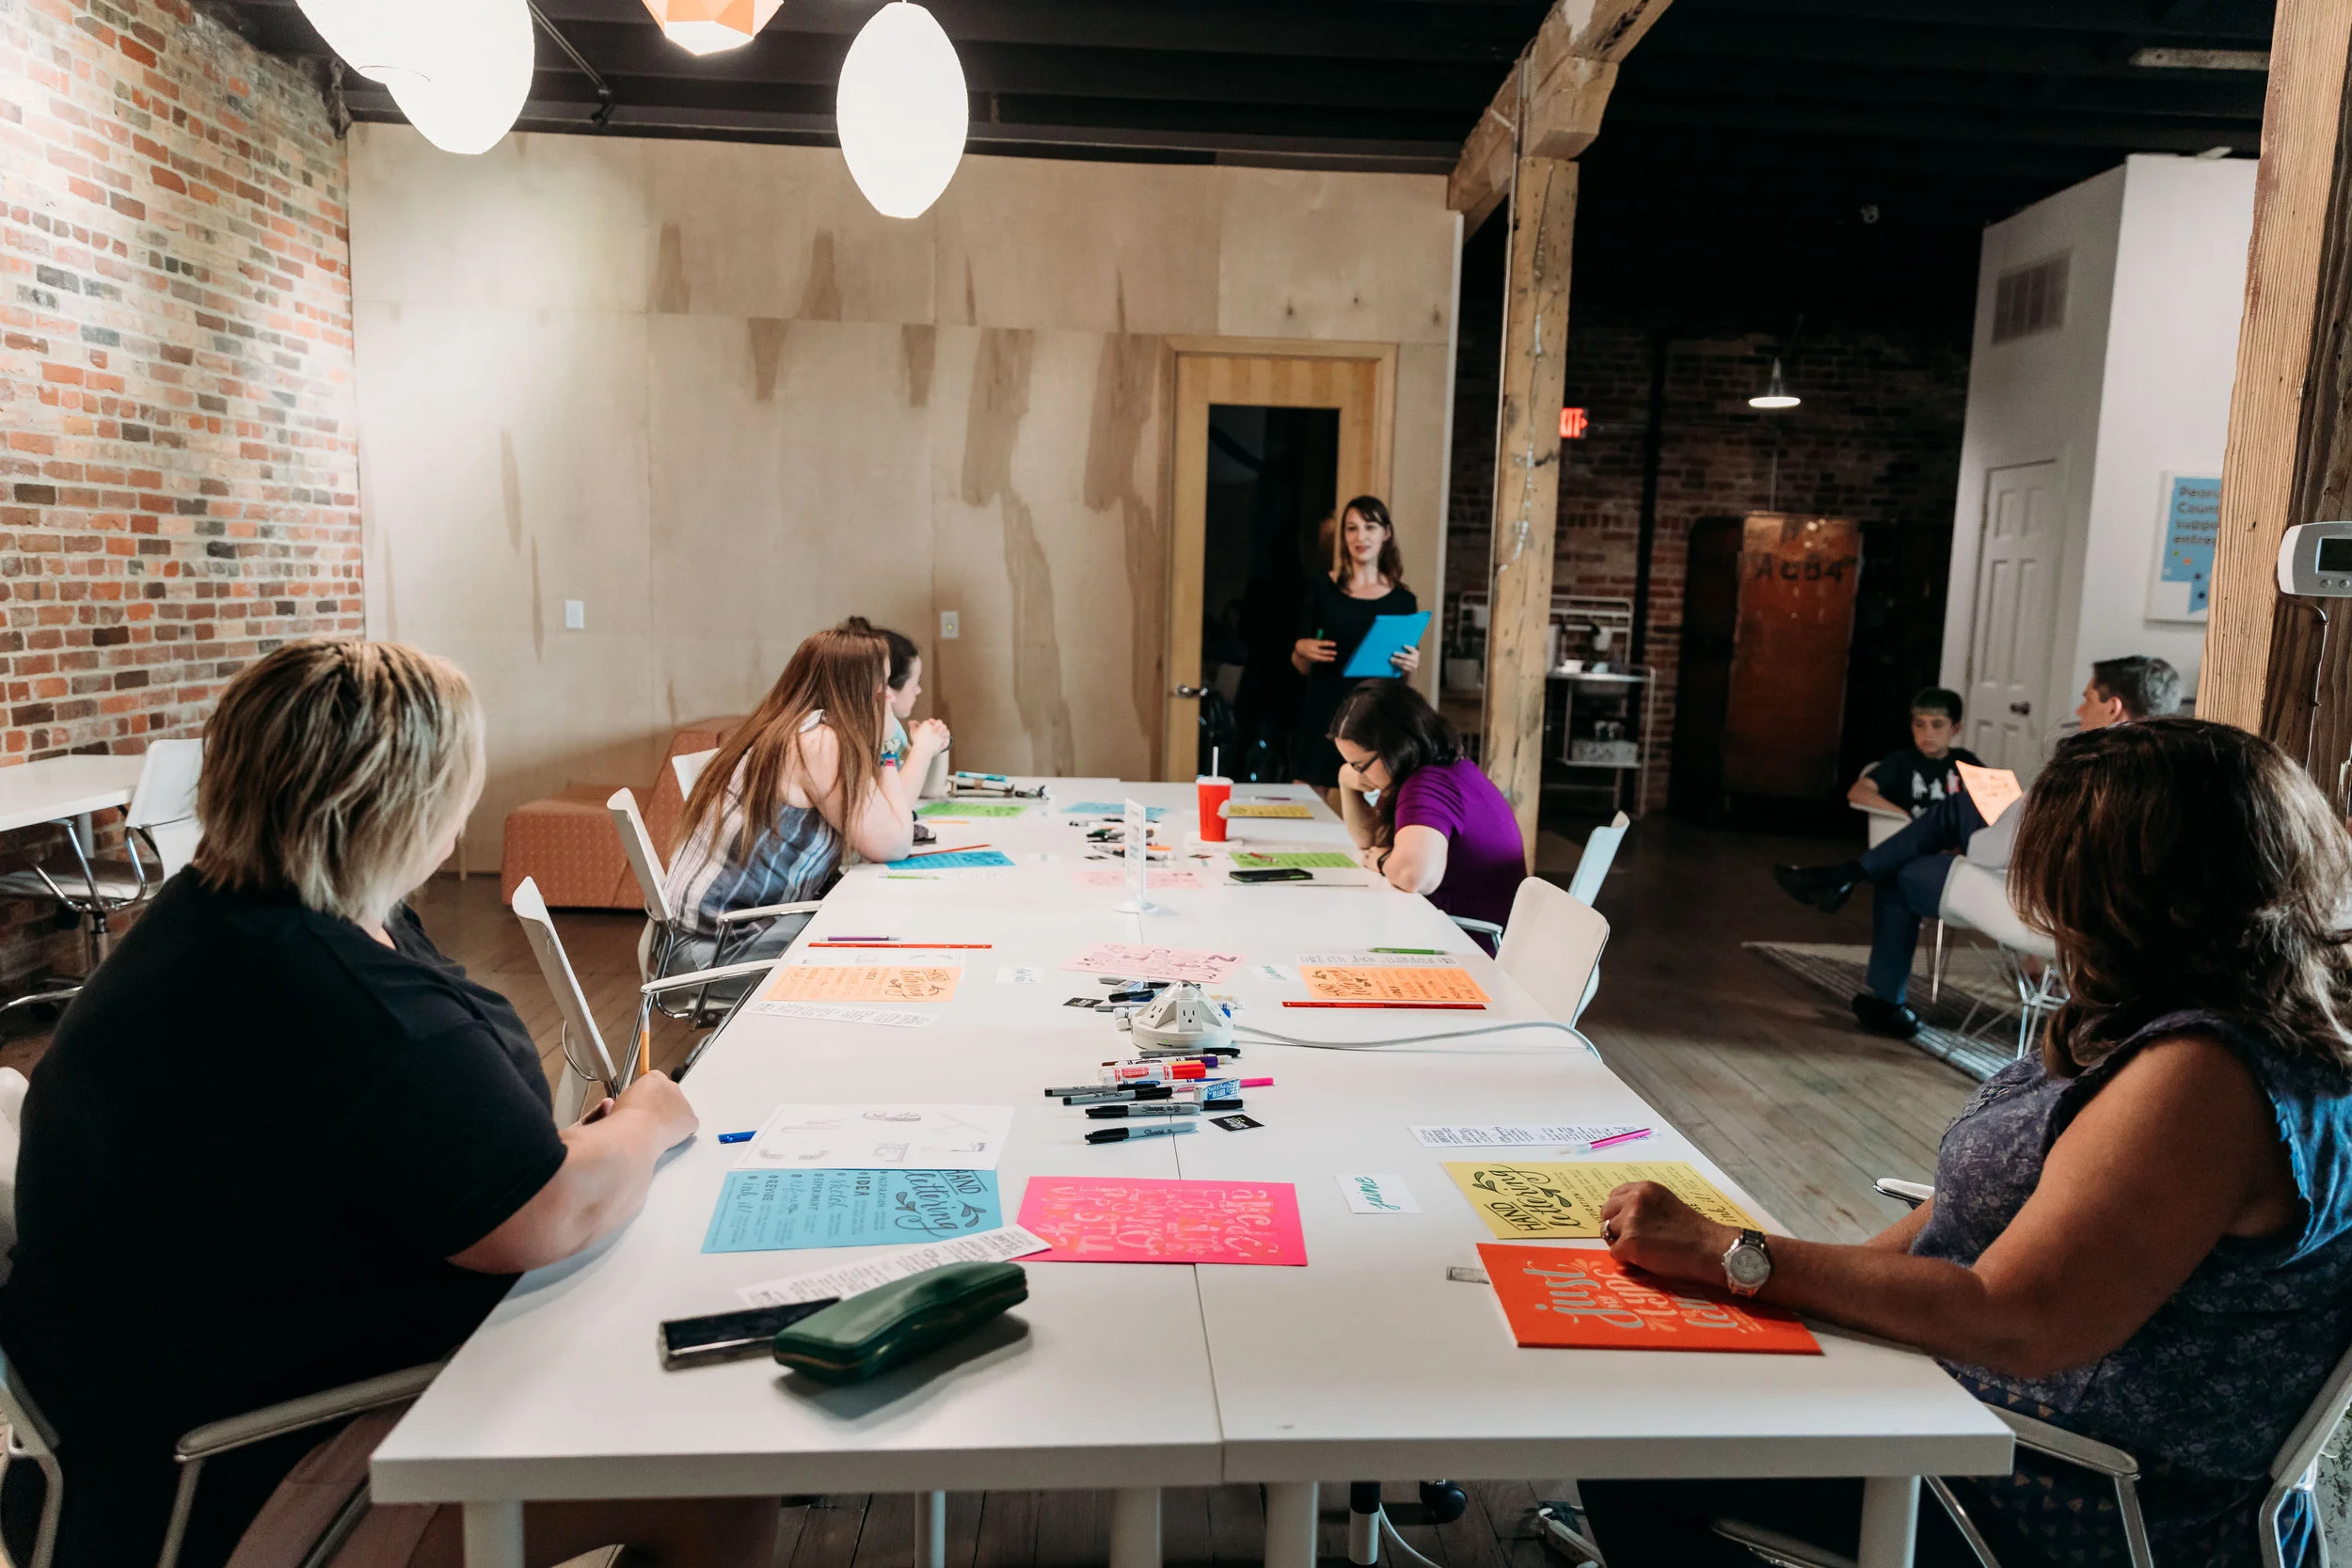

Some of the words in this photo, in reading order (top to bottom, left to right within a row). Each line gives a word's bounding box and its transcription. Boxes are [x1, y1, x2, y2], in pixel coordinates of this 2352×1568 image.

[1142, 1104, 1165, 1114] Sharpie
[762, 1179, 778, 1201] REVISE
[826, 1179, 851, 1209] sketch
[854, 1176, 870, 1196] IDEA
[1486, 1164, 1588, 1229] lettering
[894, 1170, 959, 1238] lettering
[1490, 1201, 1548, 1230] HAND
[1572, 1192, 1602, 1223] NSPIRATION
[1706, 1205, 1738, 1223] ink
[1522, 1260, 1645, 1328] just
